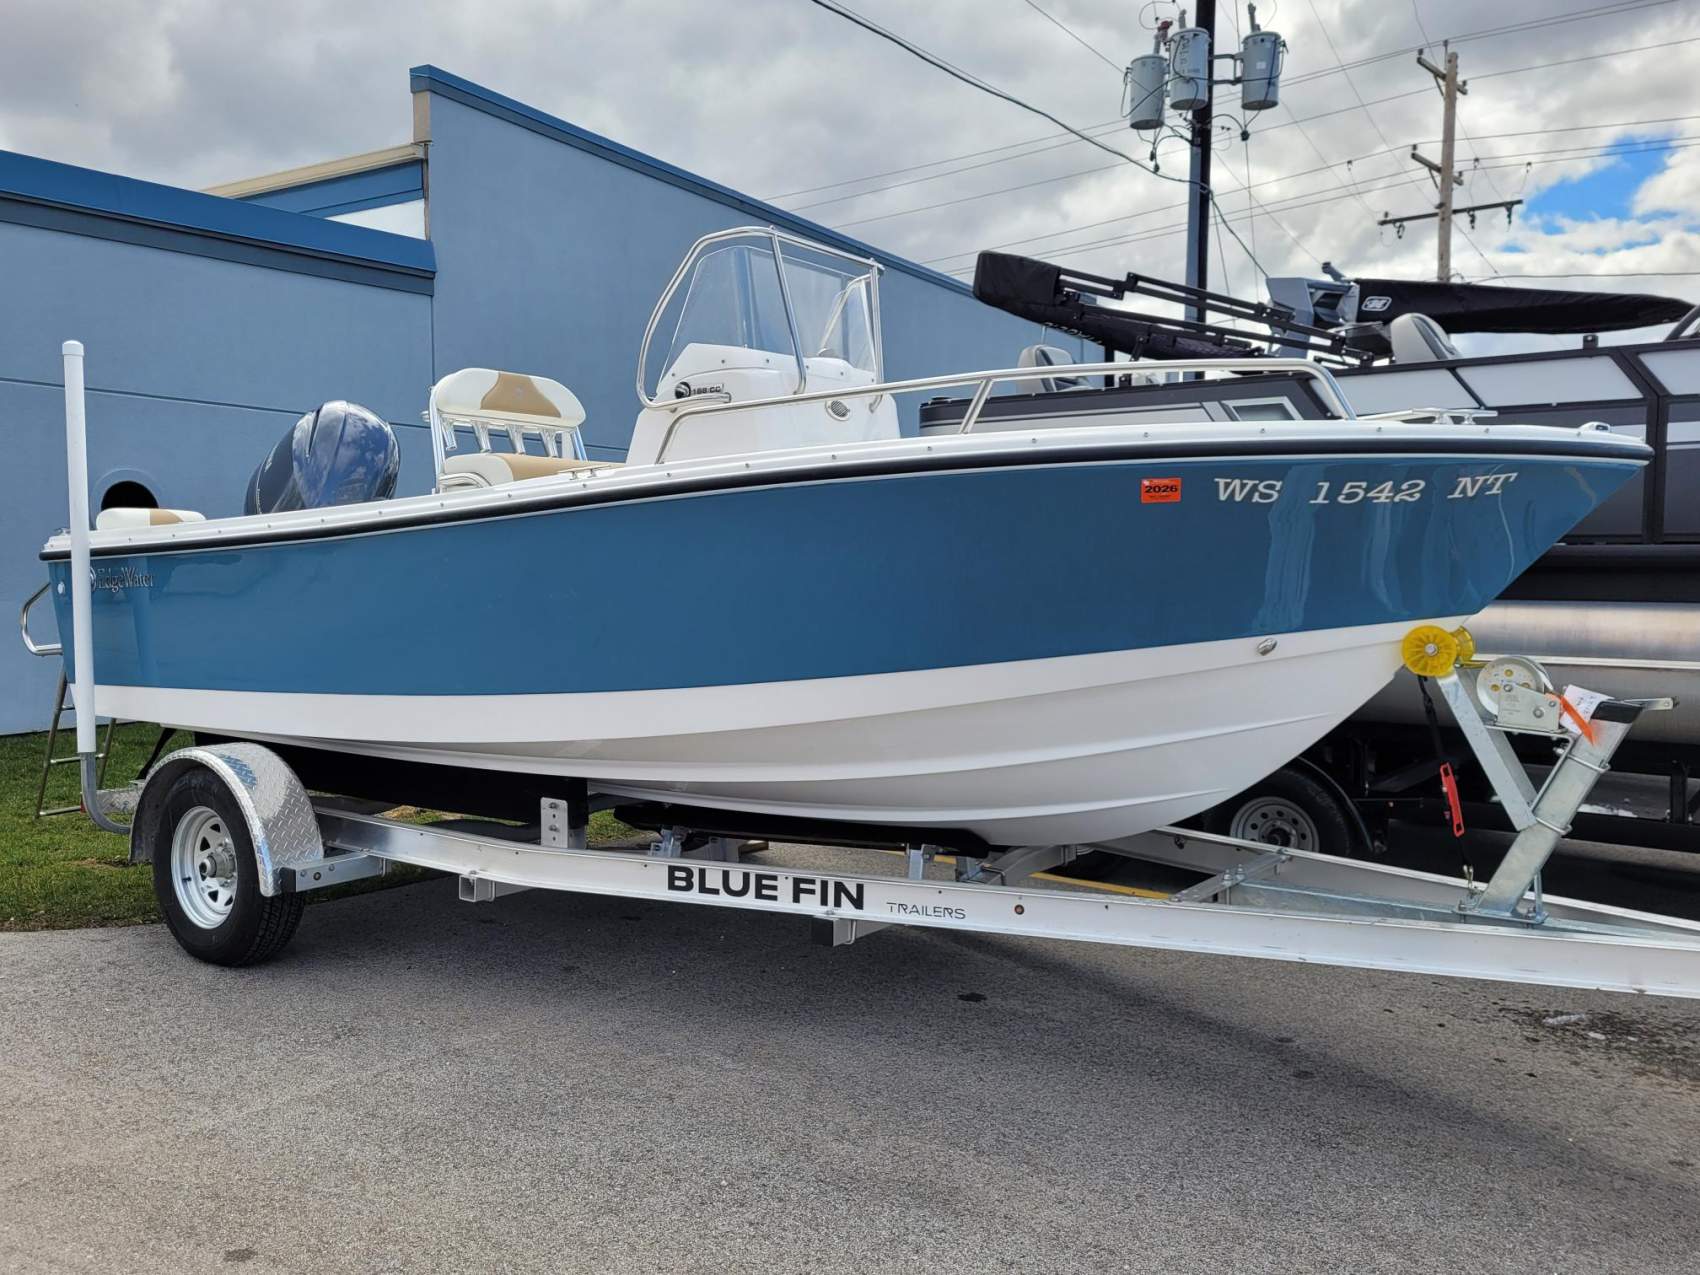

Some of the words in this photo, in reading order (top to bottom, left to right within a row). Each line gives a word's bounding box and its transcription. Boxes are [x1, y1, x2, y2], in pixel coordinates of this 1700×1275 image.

[1145, 485, 1178, 493] 2026
[1213, 478, 1283, 503] WS
[1309, 479, 1426, 504] 1542
[1447, 472, 1519, 499] NT
[95, 567, 154, 592] EdgeWater
[667, 865, 778, 901] BLUE
[792, 877, 864, 910] FIN
[886, 902, 966, 920] TRAILERS
